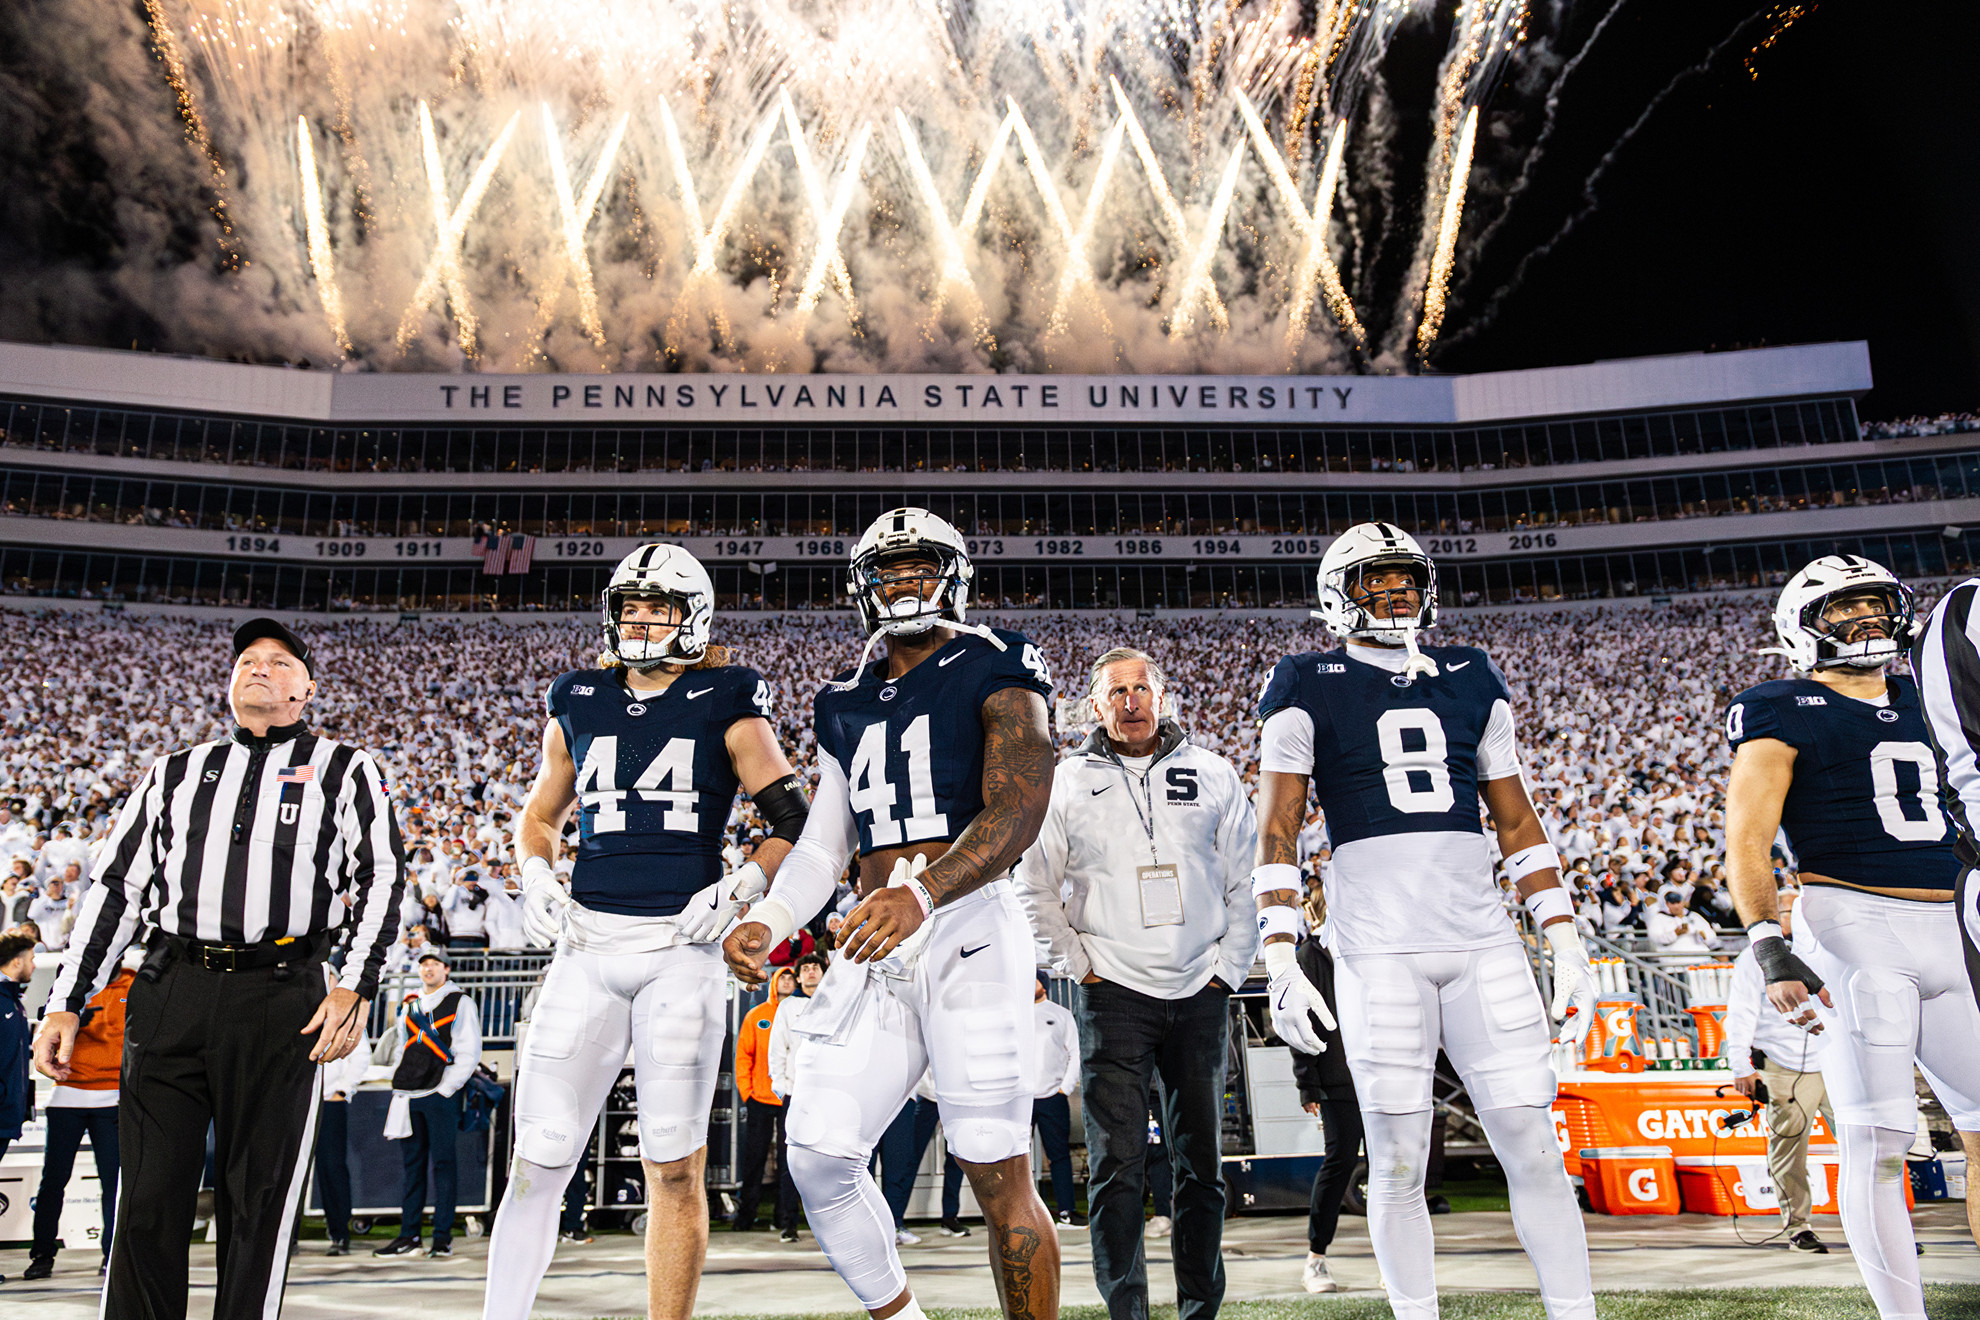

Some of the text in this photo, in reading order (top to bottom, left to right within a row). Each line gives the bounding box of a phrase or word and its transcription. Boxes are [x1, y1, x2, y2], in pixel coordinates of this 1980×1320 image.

[440, 385, 1353, 409] THE PENNSYLVANIA STATE UNIVERSITY
[227, 536, 280, 553] 1894
[315, 541, 366, 557] 1909
[395, 541, 442, 557] 1911
[555, 541, 604, 556] 1920
[714, 540, 764, 555] 1947
[795, 540, 844, 555] 1968
[968, 540, 1004, 555] 973
[1034, 540, 1083, 555] 1982
[1114, 540, 1162, 555] 1986
[1192, 540, 1241, 555] 1994
[1272, 540, 1321, 555] 2005
[1429, 539, 1478, 554] 2012
[1509, 533, 1558, 550] 2016
[1376, 708, 1456, 813] 8
[203, 769, 220, 783] S
[576, 735, 699, 833] 44
[849, 714, 949, 847] 41
[1166, 767, 1199, 801] S
[1870, 741, 1947, 842] 0
[280, 803, 300, 825] U
[1141, 870, 1174, 879] OPERATIONS
[1607, 1010, 1632, 1037] G
[1628, 1168, 1659, 1201] G
[617, 1189, 628, 1202] S
